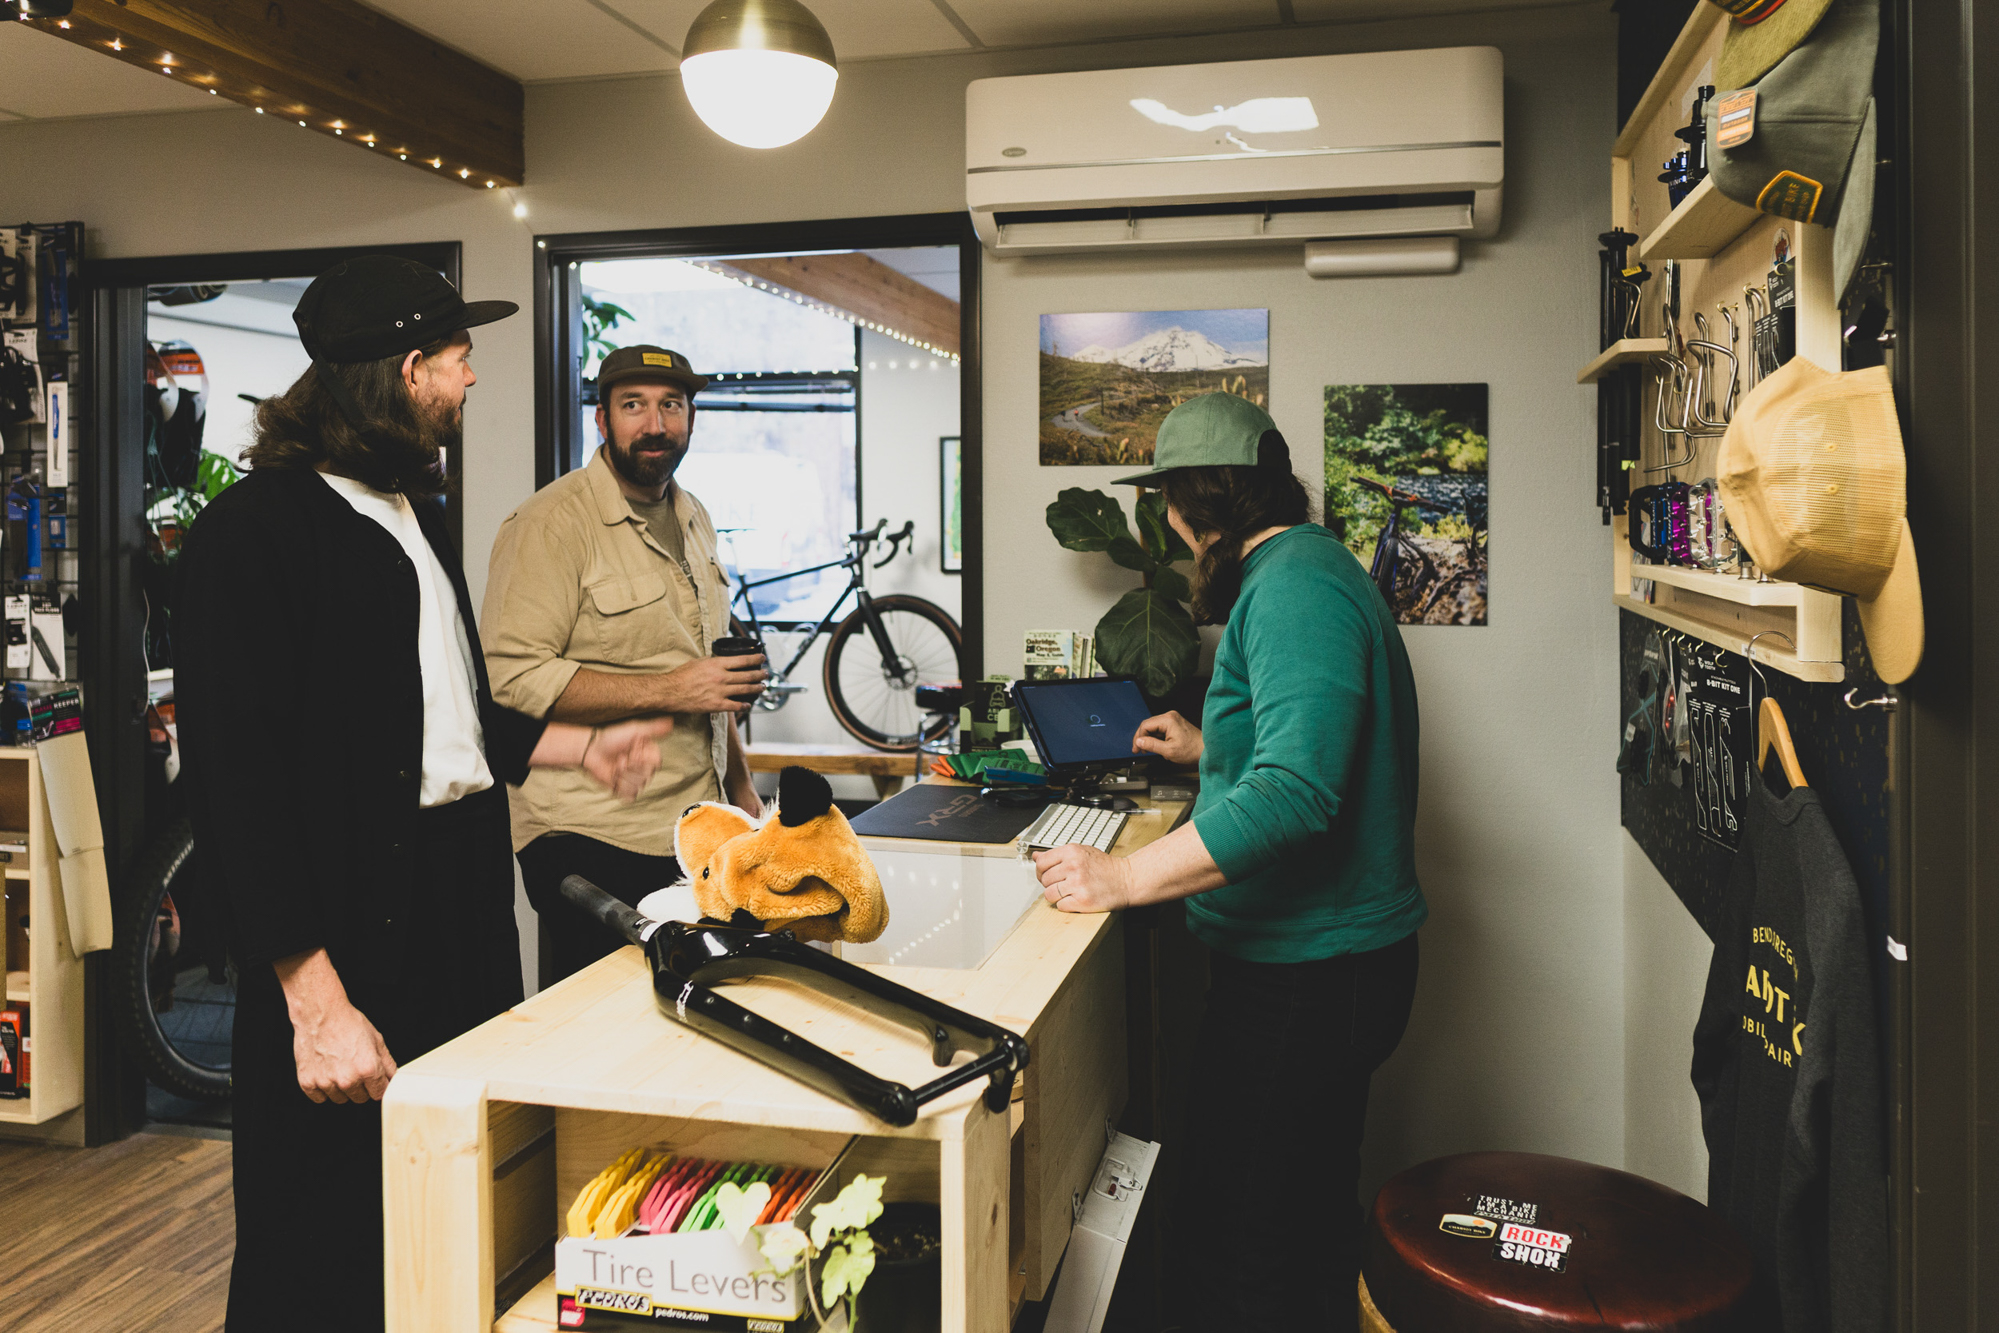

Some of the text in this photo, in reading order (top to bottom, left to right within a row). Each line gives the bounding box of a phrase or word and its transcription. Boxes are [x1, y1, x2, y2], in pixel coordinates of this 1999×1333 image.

[1476, 1204, 1536, 1220] MECHANIC
[1478, 1200, 1495, 1208] I'M
[1511, 1205, 1537, 1216] BIKE
[1480, 1194, 1538, 1212] TRUST ME
[1506, 1226, 1564, 1249] ROCK
[1500, 1242, 1560, 1268] SHOX
[582, 1248, 786, 1303] Tire Levers
[655, 1308, 709, 1322] pedros.com
